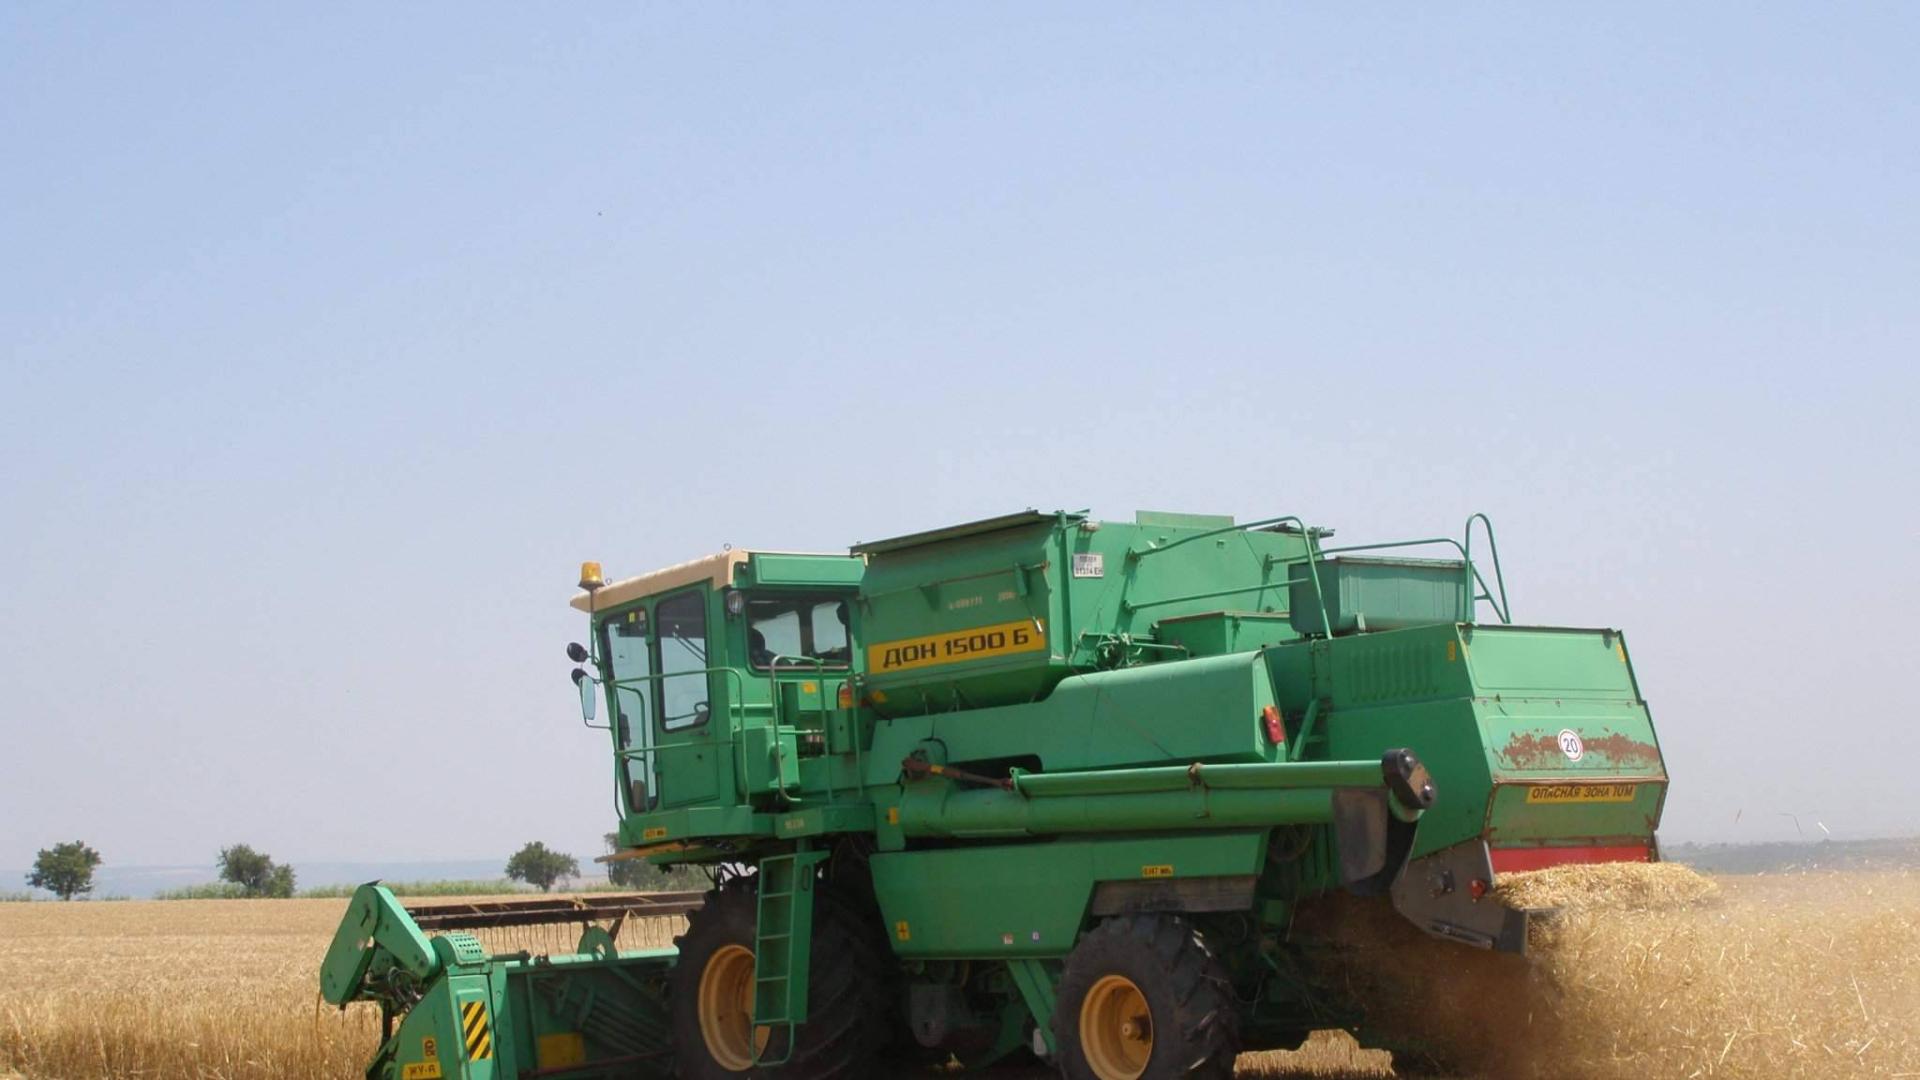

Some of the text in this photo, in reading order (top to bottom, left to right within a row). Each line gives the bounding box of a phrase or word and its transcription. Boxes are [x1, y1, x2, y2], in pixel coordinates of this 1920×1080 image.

[883, 628, 1029, 668] ДОН 1500 Б
[1563, 739, 1578, 753] 20
[1532, 785, 1580, 799] ОПАСНАЯ
[1583, 785, 1609, 797] ЗОНА
